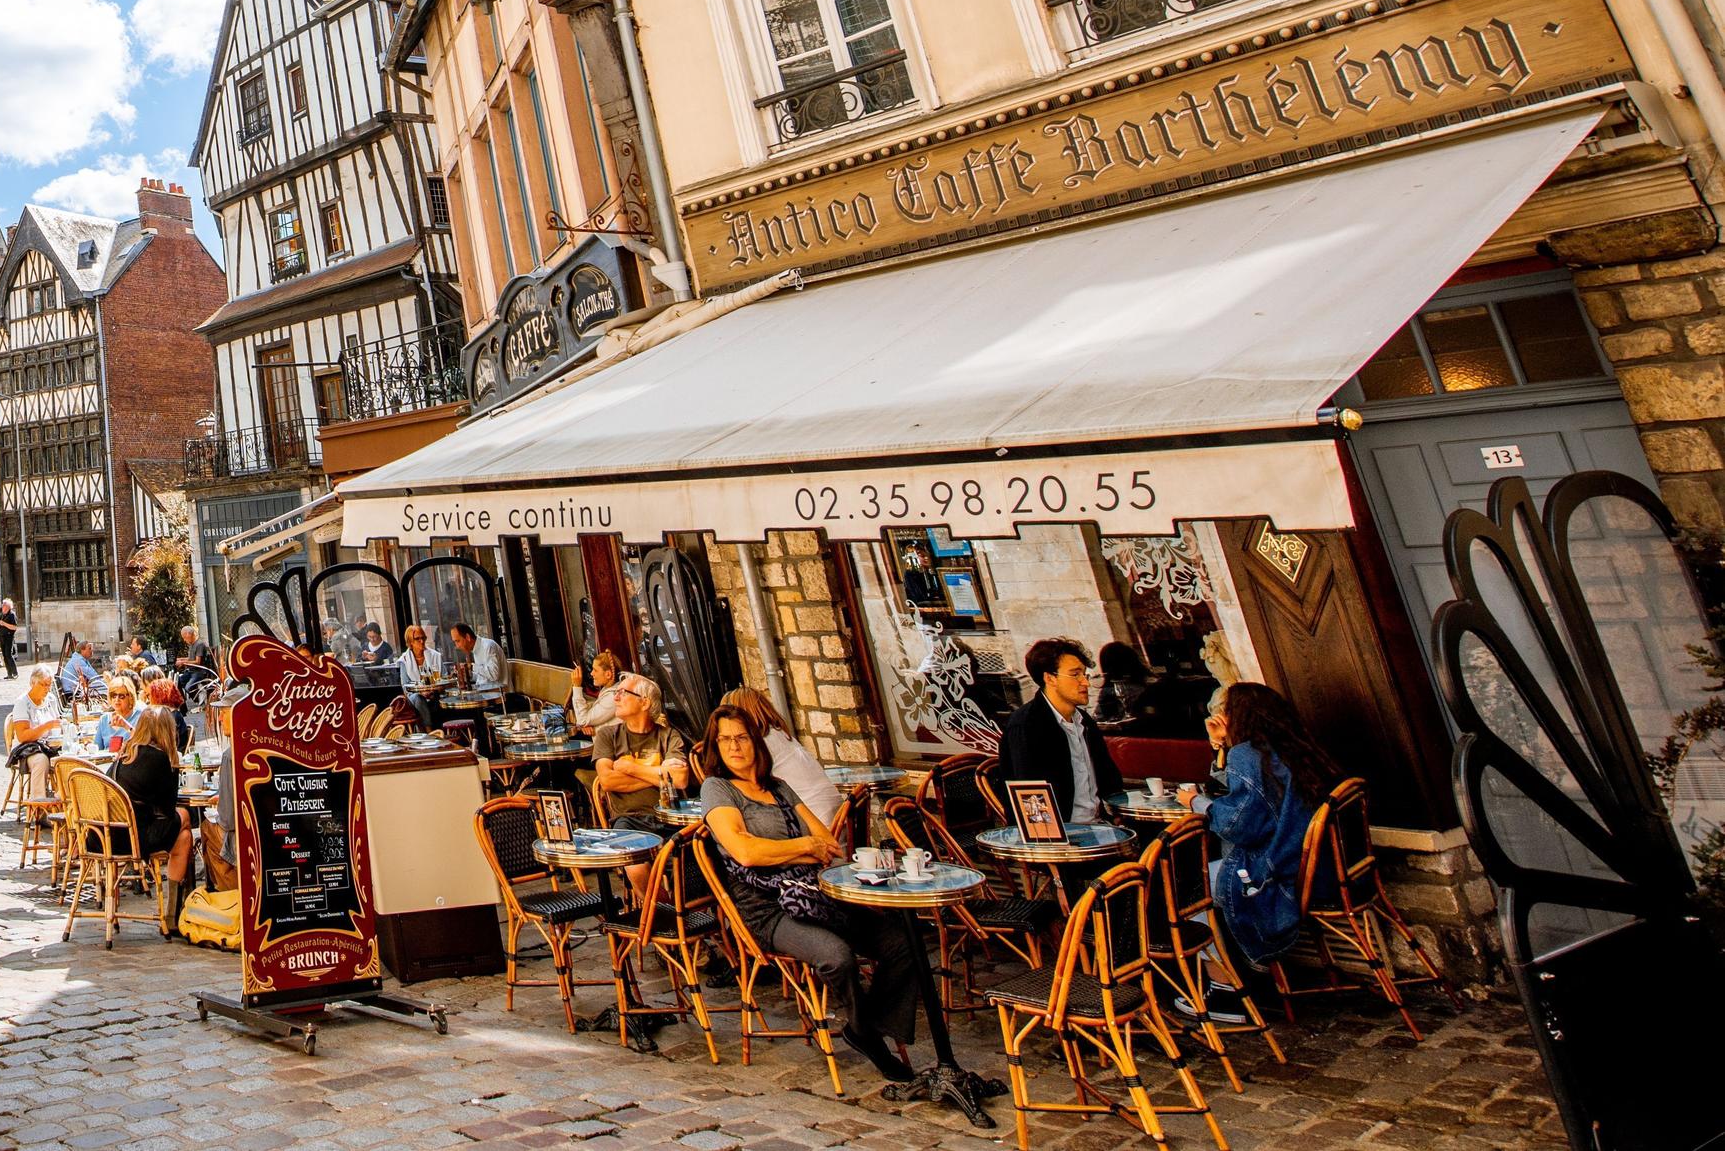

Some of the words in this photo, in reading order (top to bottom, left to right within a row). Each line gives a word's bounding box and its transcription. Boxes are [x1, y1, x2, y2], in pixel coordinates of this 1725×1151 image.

[722, 191, 880, 269] Antico
[886, 138, 1043, 224] Caffé
[1043, 17, 1534, 189] Barthélémy
[509, 310, 551, 367] CAFFÉ
[1492, 450, 1512, 464] 13
[795, 470, 1156, 521] 02.35.98.20.55
[402, 503, 491, 533] Service
[508, 498, 612, 529] continu
[252, 667, 336, 706] Antico
[267, 697, 344, 742] Caffé
[249, 729, 284, 747] Service
[285, 740, 291, 752] à
[292, 744, 313, 761] toute
[314, 749, 337, 762] heure
[261, 950, 283, 967] Petite
[288, 951, 339, 969] BRUNCH
